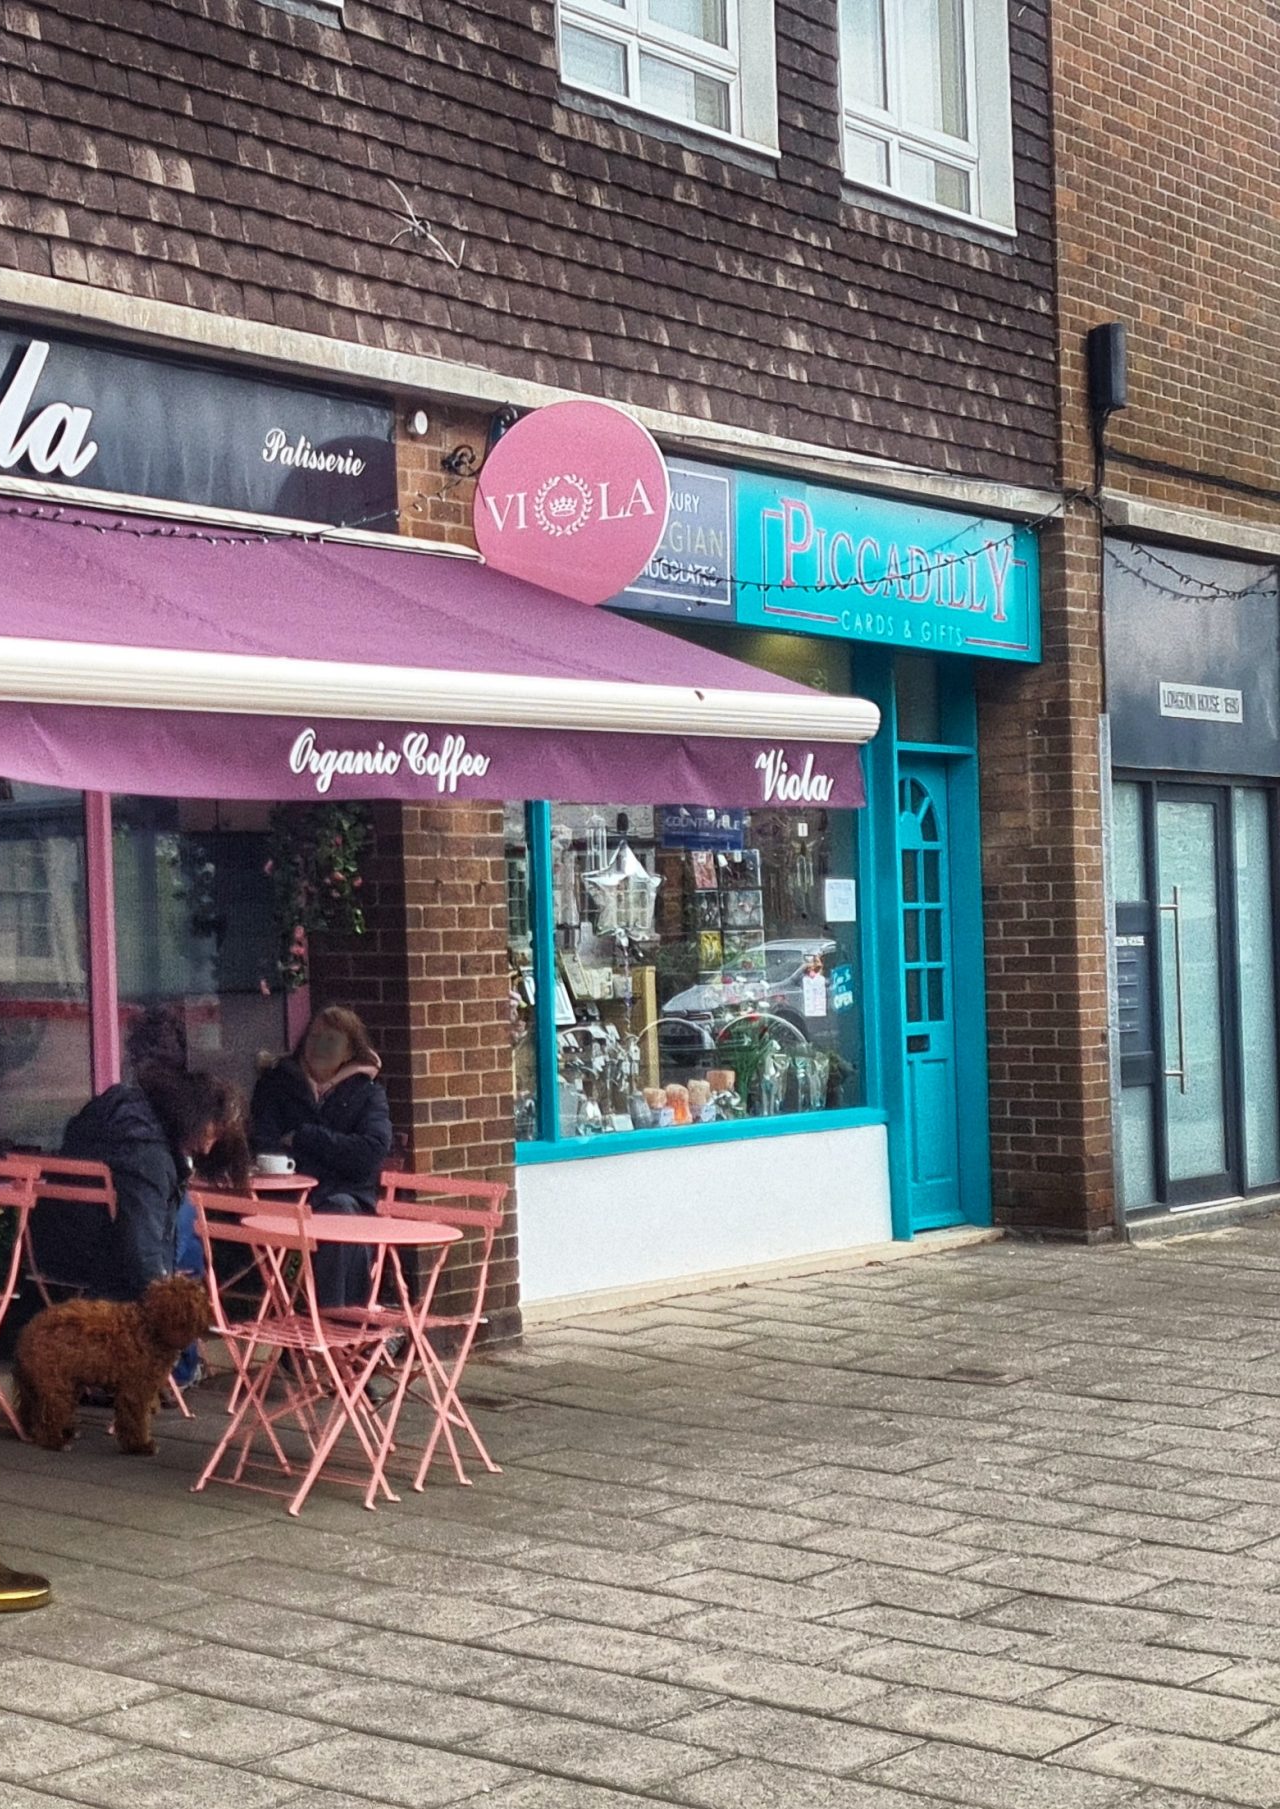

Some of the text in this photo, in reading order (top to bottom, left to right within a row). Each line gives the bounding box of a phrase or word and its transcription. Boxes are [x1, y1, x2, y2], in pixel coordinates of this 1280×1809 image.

[262, 427, 367, 477] Patisserie
[661, 520, 724, 557] GIAN
[781, 498, 1013, 622] PICCADILLY
[841, 610, 965, 647] CARDS & GIFTS
[289, 727, 491, 794] Organic Coffee
[755, 747, 835, 801] Viola
